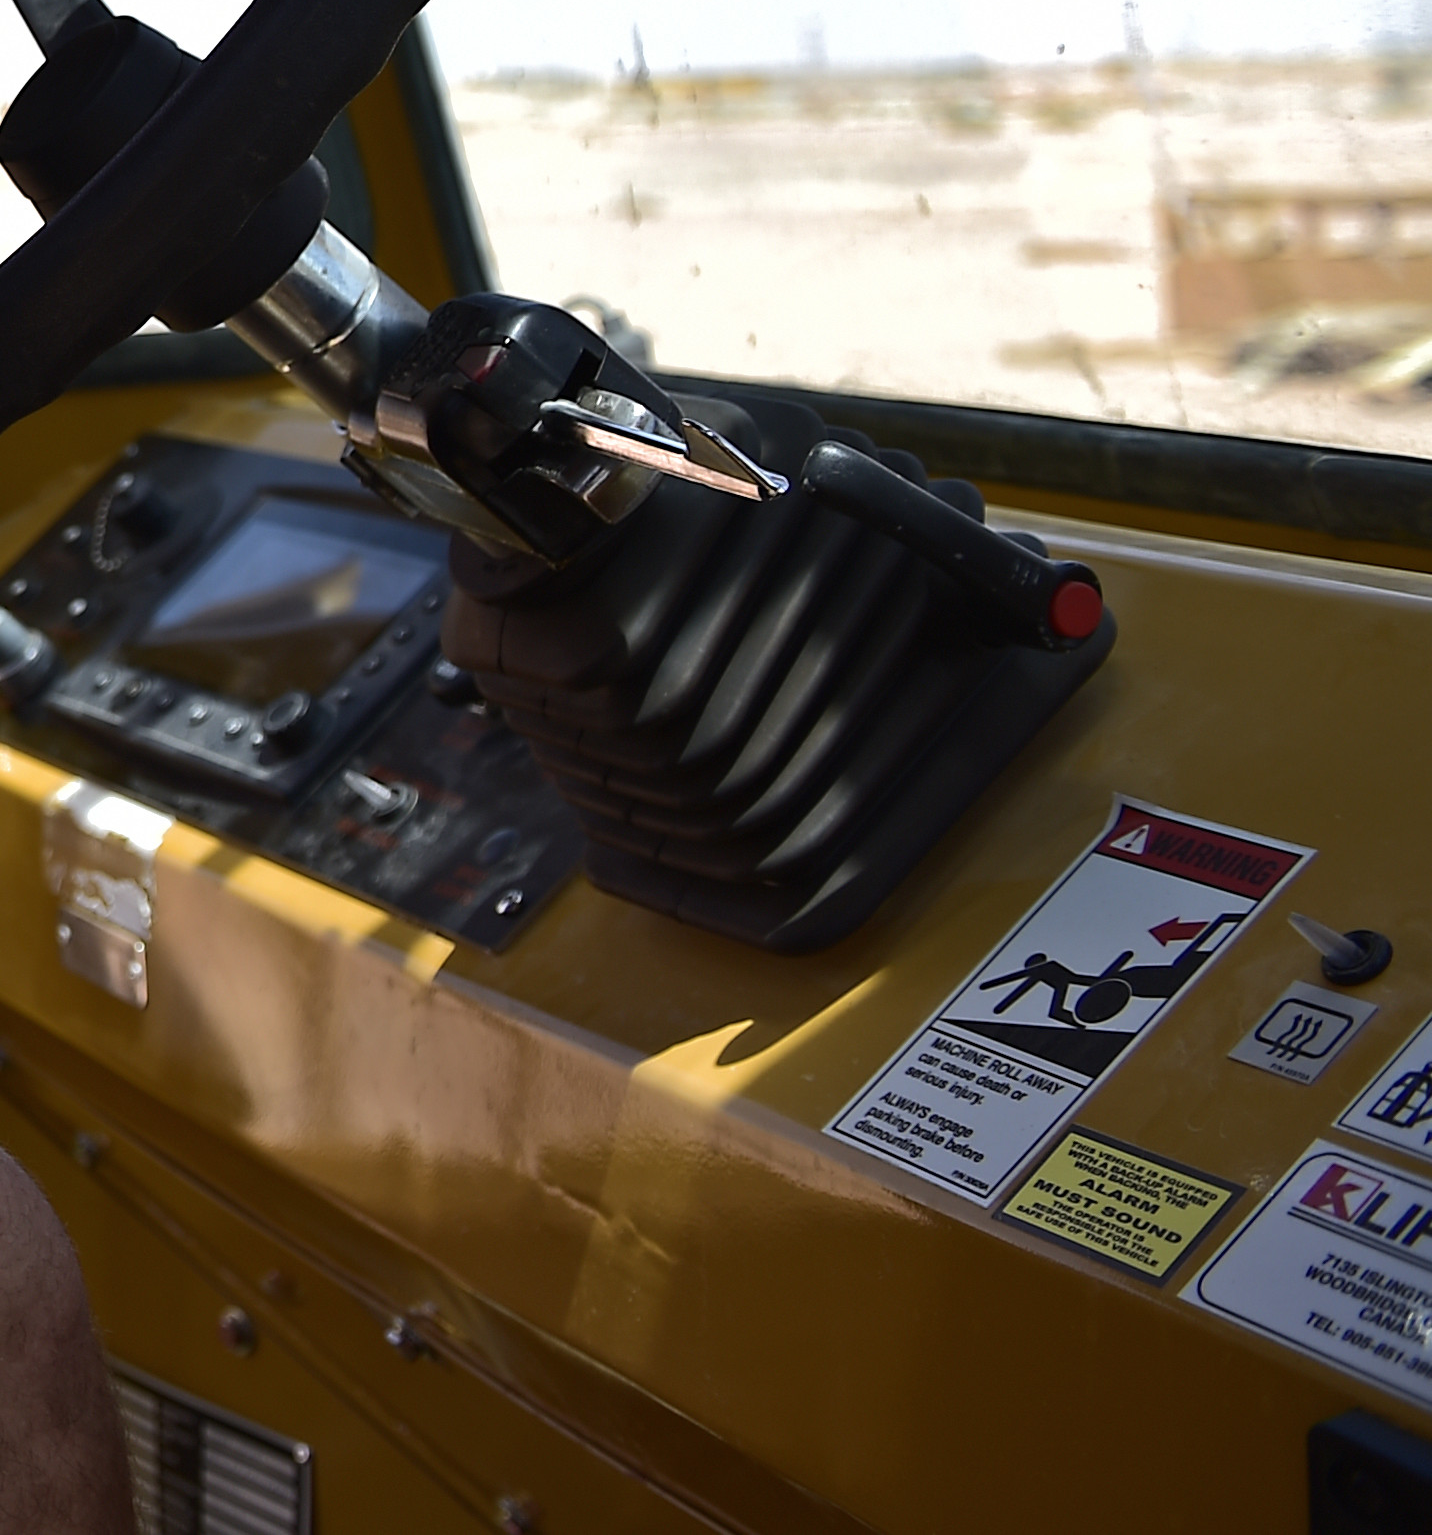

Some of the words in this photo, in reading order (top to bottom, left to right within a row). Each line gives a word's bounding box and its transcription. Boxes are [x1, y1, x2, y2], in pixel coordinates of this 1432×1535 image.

[1150, 831, 1279, 886] WARNING
[905, 1067, 949, 1089] serious
[949, 1081, 984, 1105] injury.
[918, 1053, 940, 1067] can
[940, 1062, 976, 1081] cause
[976, 1075, 1011, 1095] death
[1011, 1090, 1028, 1101] or
[931, 1037, 991, 1068] MACHINE
[988, 1059, 1022, 1082] ROLL
[1021, 1073, 1064, 1095] AWAY
[854, 1120, 924, 1158] dismounting.
[864, 1107, 911, 1133] parking
[910, 1123, 944, 1145] brake
[944, 1138, 985, 1162] before
[879, 1091, 931, 1119] ALWAYS
[928, 1114, 973, 1138] engage
[1068, 1149, 1098, 1165] WITH
[1099, 1162, 1108, 1170] A
[1110, 1165, 1164, 1188] BACK-UP
[1164, 1187, 1209, 1208] ALARM
[1072, 1141, 1096, 1154] THIS
[1099, 1151, 1145, 1172] VEHICLE
[1146, 1169, 1158, 1178] IS
[1161, 1175, 1218, 1201] EQUIPPED
[1074, 1161, 1108, 1178] WHEN
[1108, 1174, 1160, 1200] BACKING,
[1165, 1196, 1188, 1210] THE
[1033, 1179, 1098, 1208] MUST
[1101, 1206, 1182, 1243] SOUND
[1053, 1200, 1074, 1214] THE
[1075, 1210, 1132, 1236] OPERATOR
[1133, 1233, 1145, 1242] IS
[1078, 1179, 1160, 1214] ALARM
[1016, 1205, 1044, 1219] SAFE
[1044, 1216, 1066, 1228] USE
[1068, 1226, 1083, 1234] OF
[1085, 1232, 1109, 1246] THIS
[1112, 1243, 1160, 1267] VEHICLE
[1033, 1202, 1104, 1235] RESPONSIBLE
[1105, 1232, 1129, 1245] FOR
[1131, 1242, 1154, 1255] THE
[1322, 1253, 1360, 1276] 7135
[1306, 1311, 1340, 1336] TEL:
